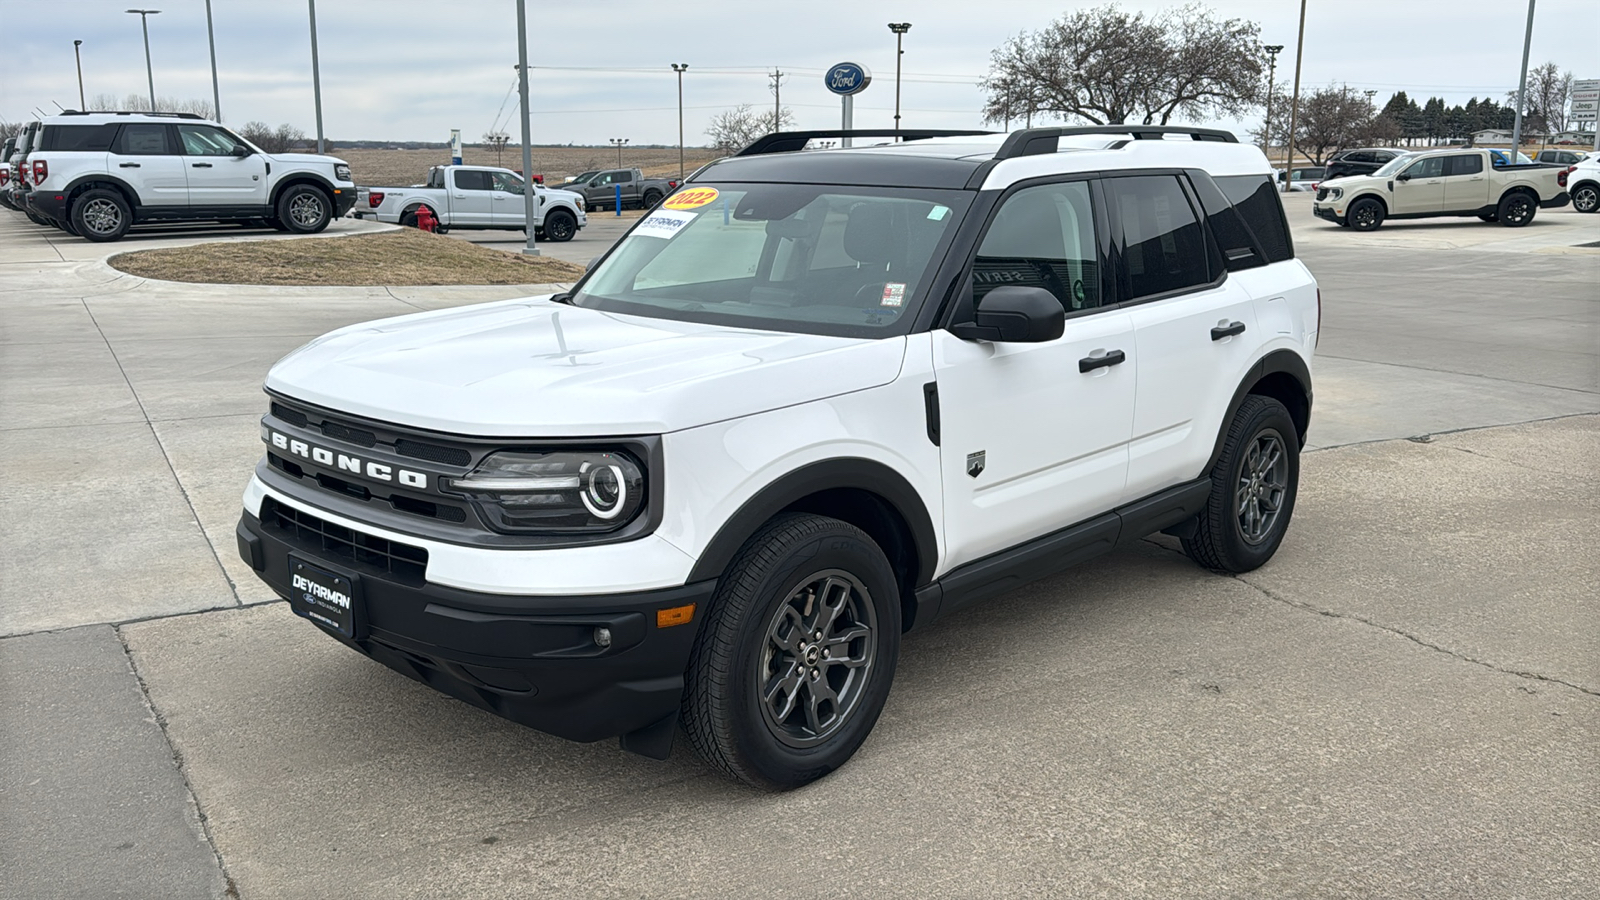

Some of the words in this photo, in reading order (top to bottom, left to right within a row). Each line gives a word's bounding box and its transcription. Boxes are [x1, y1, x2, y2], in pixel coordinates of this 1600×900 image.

[832, 69, 855, 88] Ford
[666, 192, 716, 205] 2022
[272, 432, 427, 488] BRONCO
[292, 574, 350, 609] DEYARMAN
